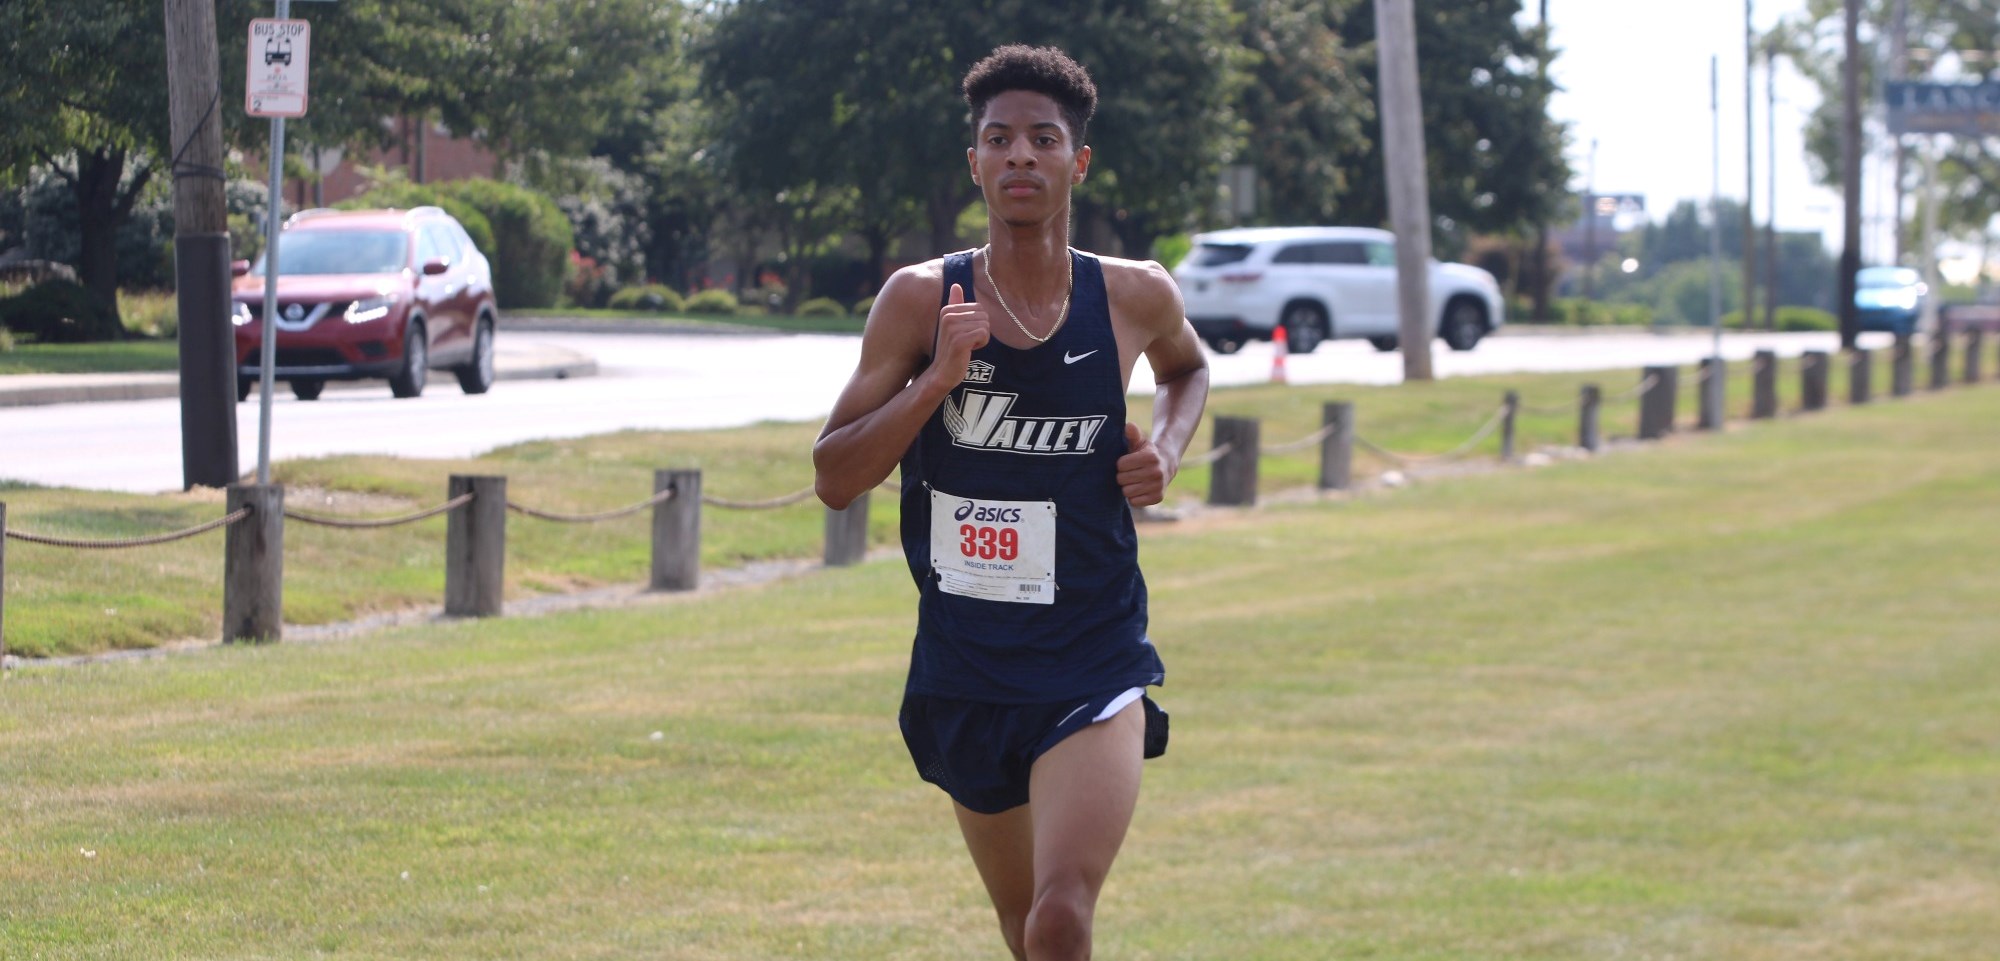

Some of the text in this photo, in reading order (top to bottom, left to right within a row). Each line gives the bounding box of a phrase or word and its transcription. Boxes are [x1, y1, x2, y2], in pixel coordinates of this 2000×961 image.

[254, 24, 305, 36] BUS STOP
[955, 391, 1101, 452] VALLEY
[959, 524, 1019, 561] 339
[964, 560, 1014, 571] INSIDE TRACK
